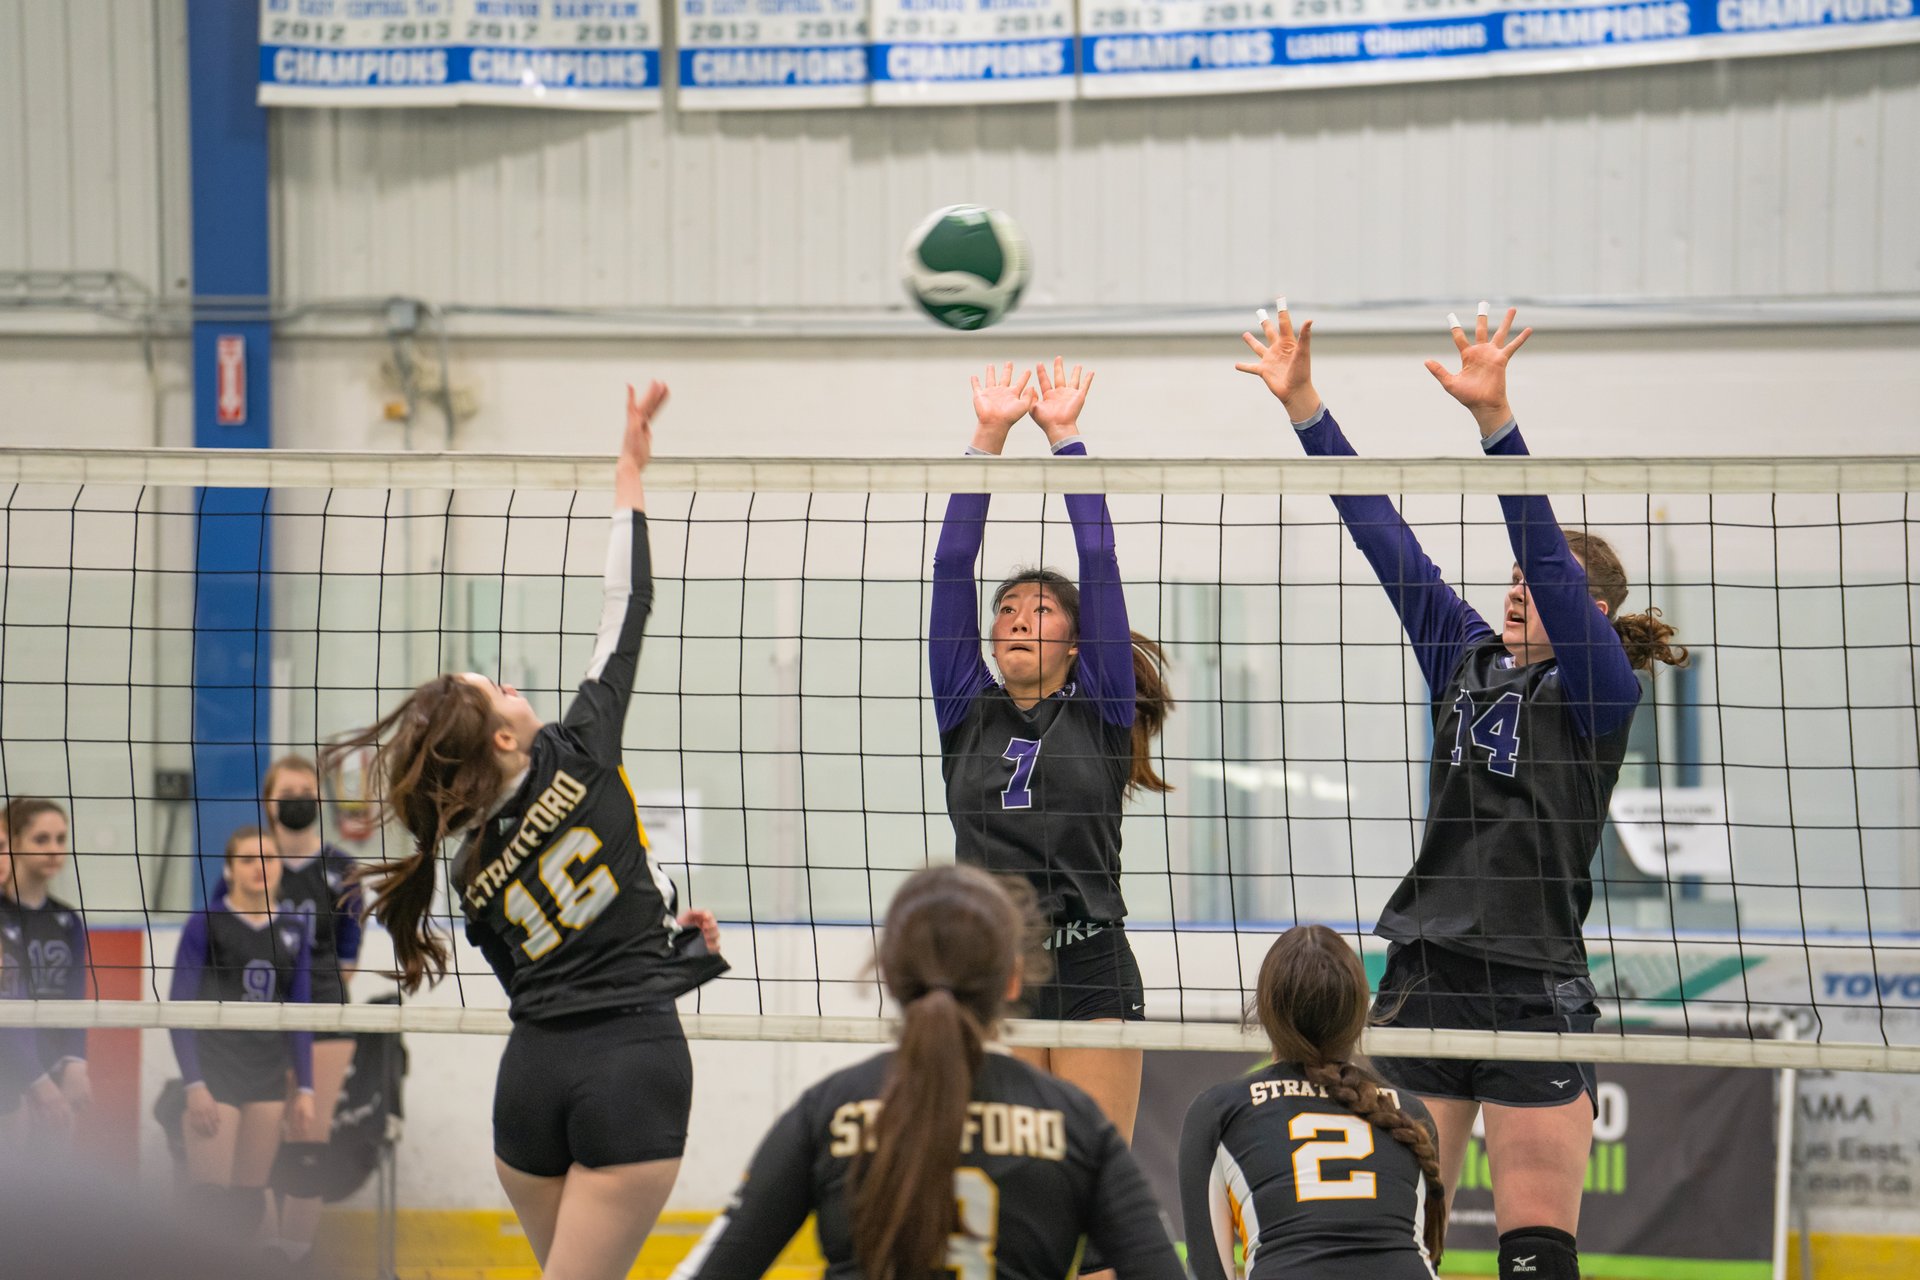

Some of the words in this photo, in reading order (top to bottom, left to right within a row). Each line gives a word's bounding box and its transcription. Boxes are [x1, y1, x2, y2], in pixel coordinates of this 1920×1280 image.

[273, 20, 345, 42] 2012
[383, 20, 451, 40] 2013
[1363, 23, 1487, 56] CHAMPIONS
[1502, 1, 1691, 48] CHAMPIONS
[273, 49, 450, 84] CHAMPIONS
[469, 49, 650, 87] CHAMPIONS
[692, 48, 869, 85] CHAMPIONS
[886, 41, 1065, 81] CHAMPIONS
[1094, 31, 1275, 71] CHAMPIONS
[1451, 688, 1523, 778] 14
[1001, 736, 1042, 810] 7
[464, 769, 588, 910] STRATFORD
[504, 826, 620, 961] 16
[829, 1099, 1067, 1162] STFORD
[1288, 1112, 1377, 1203] 2
